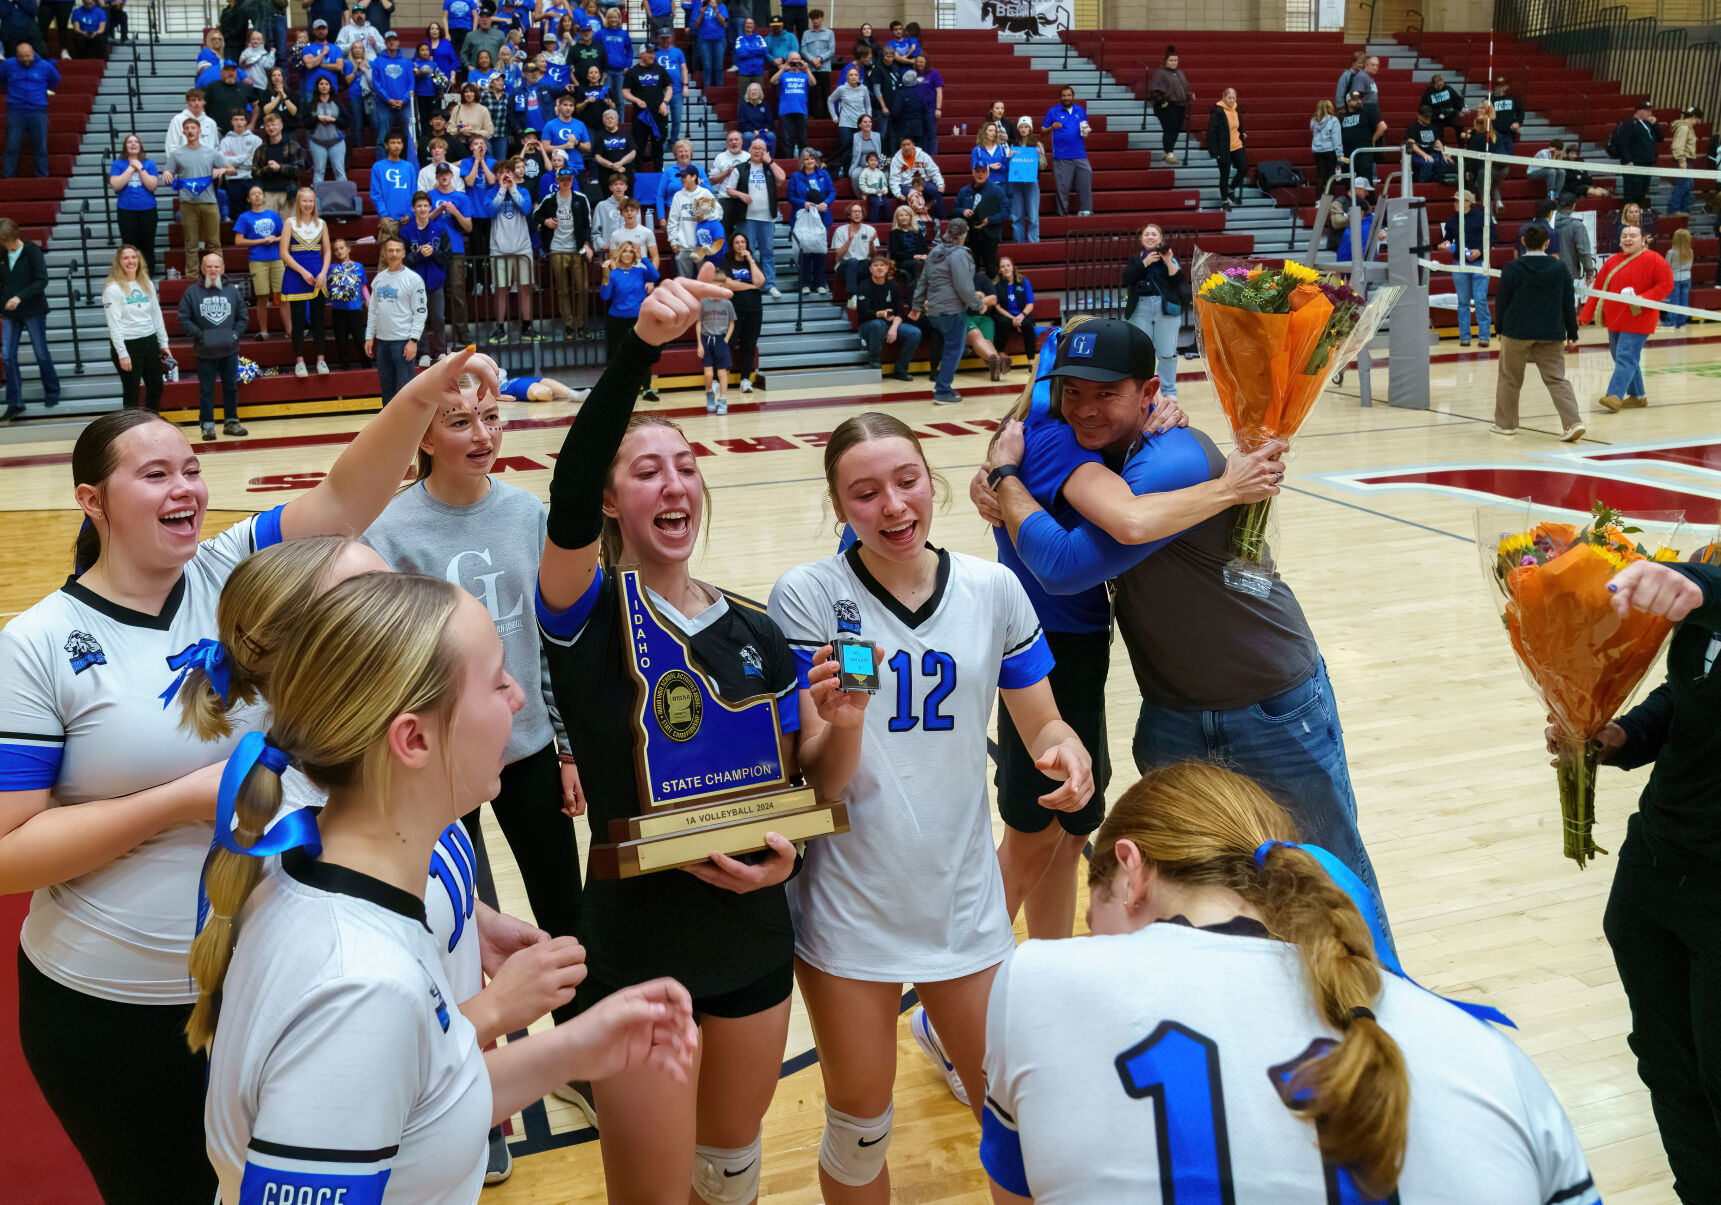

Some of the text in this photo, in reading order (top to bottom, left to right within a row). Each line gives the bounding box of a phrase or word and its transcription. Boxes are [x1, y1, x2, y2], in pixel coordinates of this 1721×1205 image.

[385, 168, 408, 189] GL
[1073, 336, 1090, 355] GL
[632, 599, 650, 669] IDAHO
[888, 649, 957, 732] 12
[662, 763, 772, 793] STATE CHAMPION
[686, 801, 775, 825] 1A VOLLEYBALL 2024
